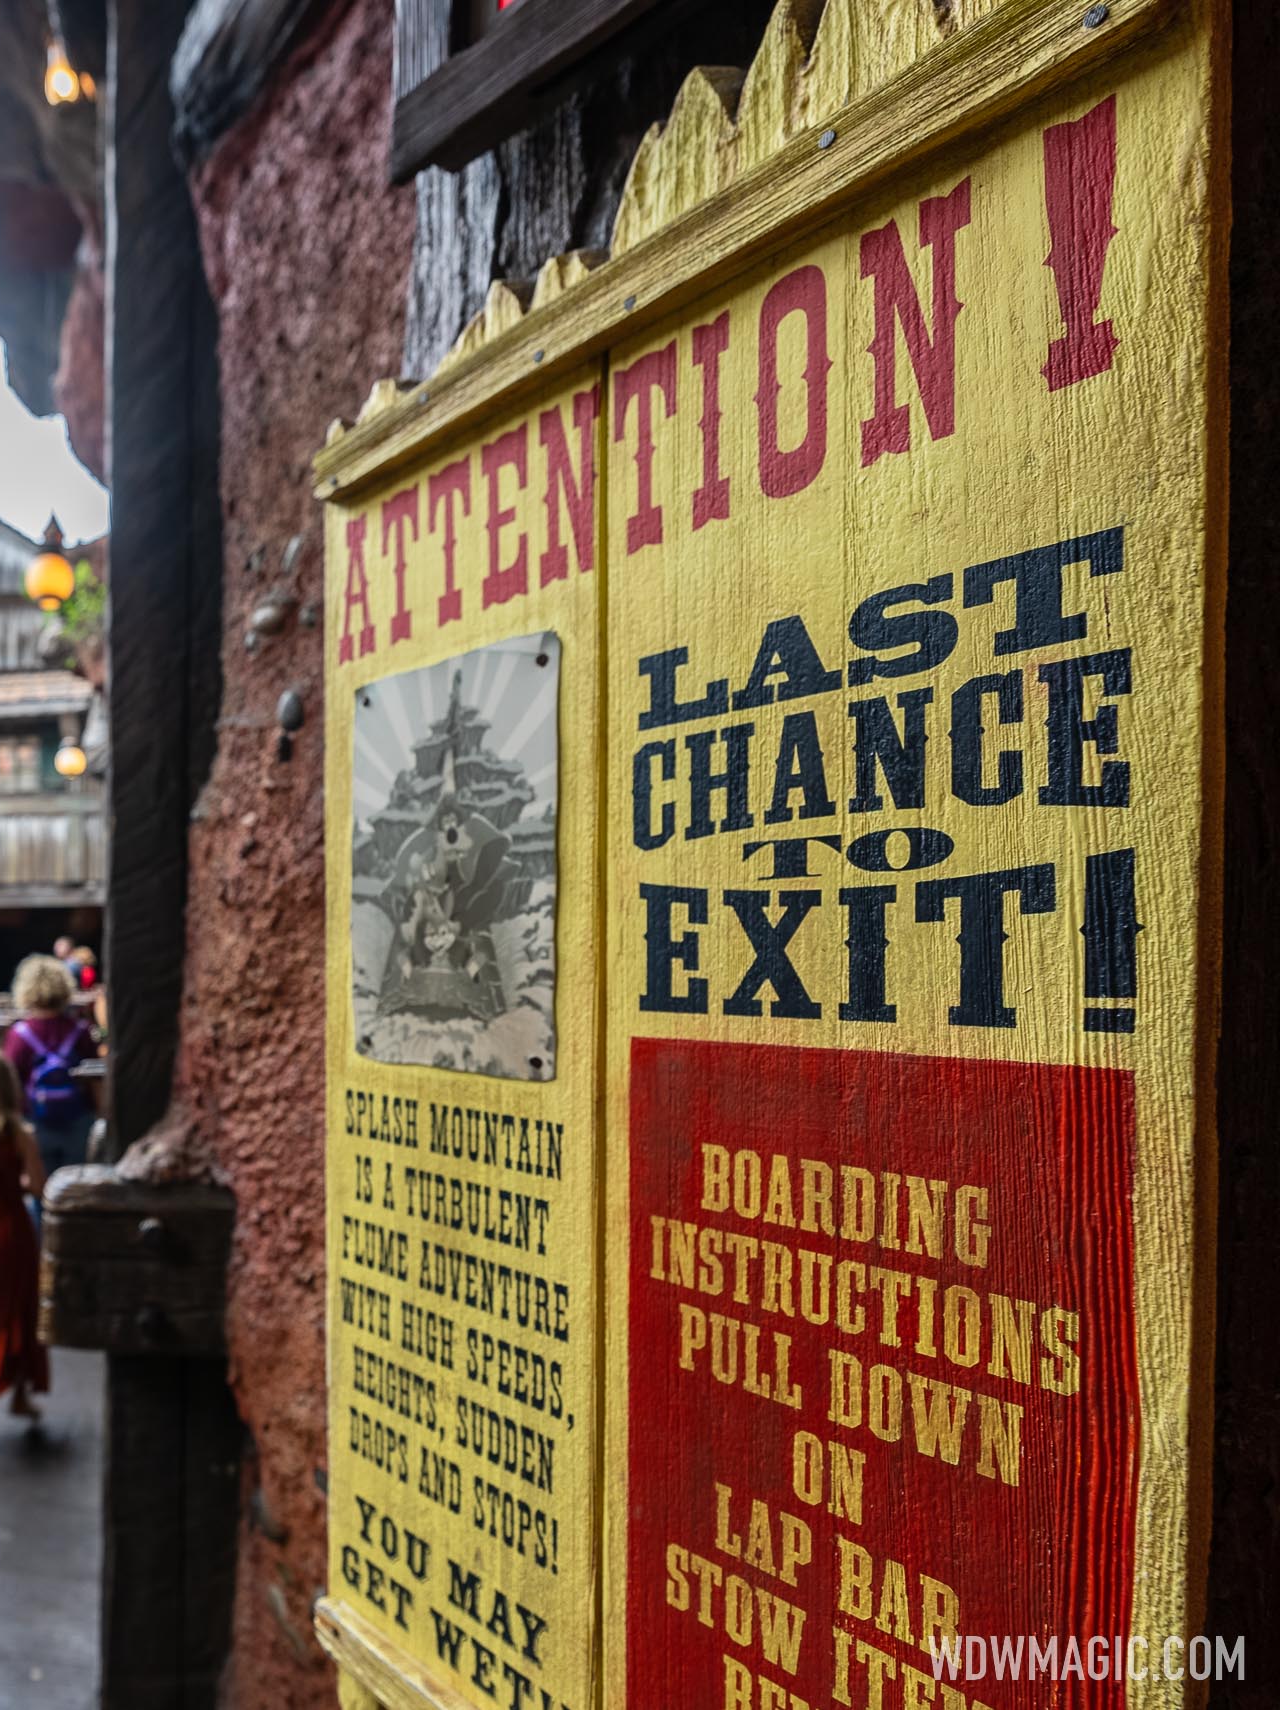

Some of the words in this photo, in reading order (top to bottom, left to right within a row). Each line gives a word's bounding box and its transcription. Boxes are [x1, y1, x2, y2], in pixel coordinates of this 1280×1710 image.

[637, 526, 1125, 731] LAST
[632, 647, 1132, 851] CHANCE
[742, 827, 954, 880] TO
[639, 847, 1145, 1033] EXIT!
[345, 1089, 419, 1149] SPLASH
[429, 1102, 564, 1181] MOUNTAIN
[355, 1154, 373, 1204] IS
[383, 1162, 395, 1210] A
[405, 1167, 549, 1256] TURBULENT
[700, 1142, 993, 1269] BOARDING
[340, 1277, 391, 1341] WITH
[401, 1301, 454, 1370] HIGH
[466, 1327, 574, 1432] SPEEDS,
[342, 1215, 409, 1282] FLUME
[419, 1241, 569, 1343] ADVENTURE
[649, 1214, 1081, 1397] INSTRUCTIONS
[353, 1345, 445, 1442] HEIGHTS,
[456, 1395, 555, 1495] SUDDEN
[678, 1303, 803, 1409] PULL
[827, 1348, 1024, 1487] DOWN
[349, 1405, 409, 1484] DROPS
[418, 1446, 462, 1515] AND
[473, 1475, 559, 1576] STOPS!
[792, 1431, 867, 1525] ON
[341, 1545, 413, 1632] GET
[355, 1495, 431, 1581] YOU
[447, 1559, 548, 1670] MAY
[665, 1542, 806, 1675] STOW
[714, 1482, 812, 1587] LAP
[834, 1533, 964, 1669] BAR
